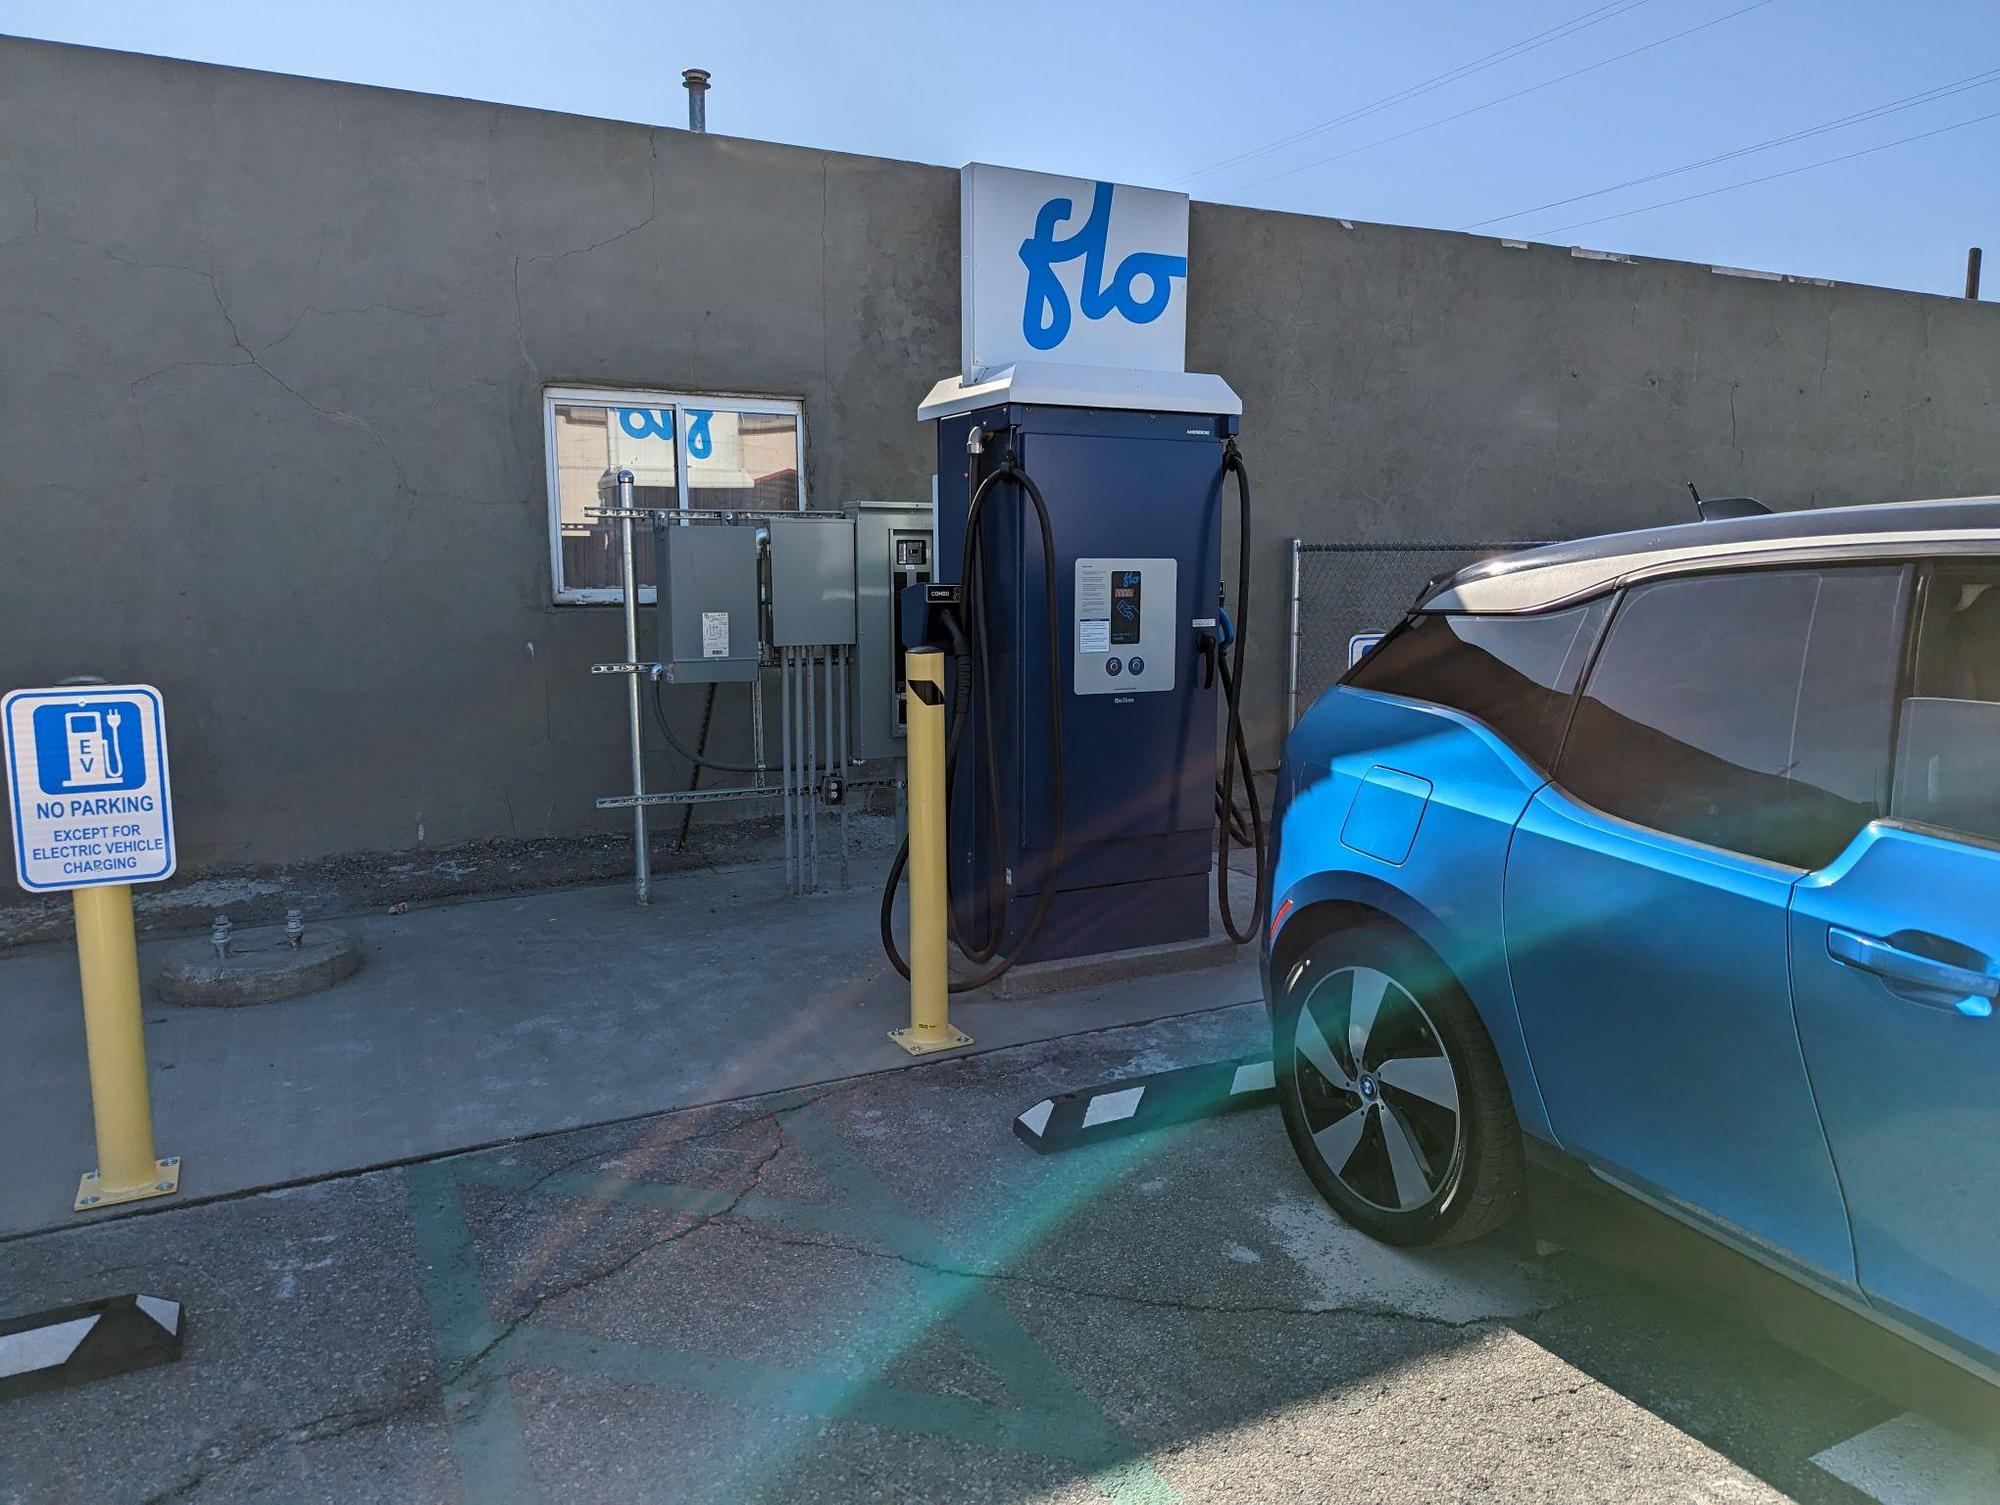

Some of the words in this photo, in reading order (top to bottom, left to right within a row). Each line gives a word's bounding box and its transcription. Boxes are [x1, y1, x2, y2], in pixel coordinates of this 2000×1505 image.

[1018, 181, 1187, 350] flo
[37, 801, 65, 820] NO
[70, 795, 154, 817] PARKING
[54, 826, 109, 842] EXCEPT
[112, 824, 141, 837] FOR
[33, 843, 102, 861] ELECTRIC
[105, 838, 164, 854] VEHICLE
[63, 856, 137, 874] CHARGING
